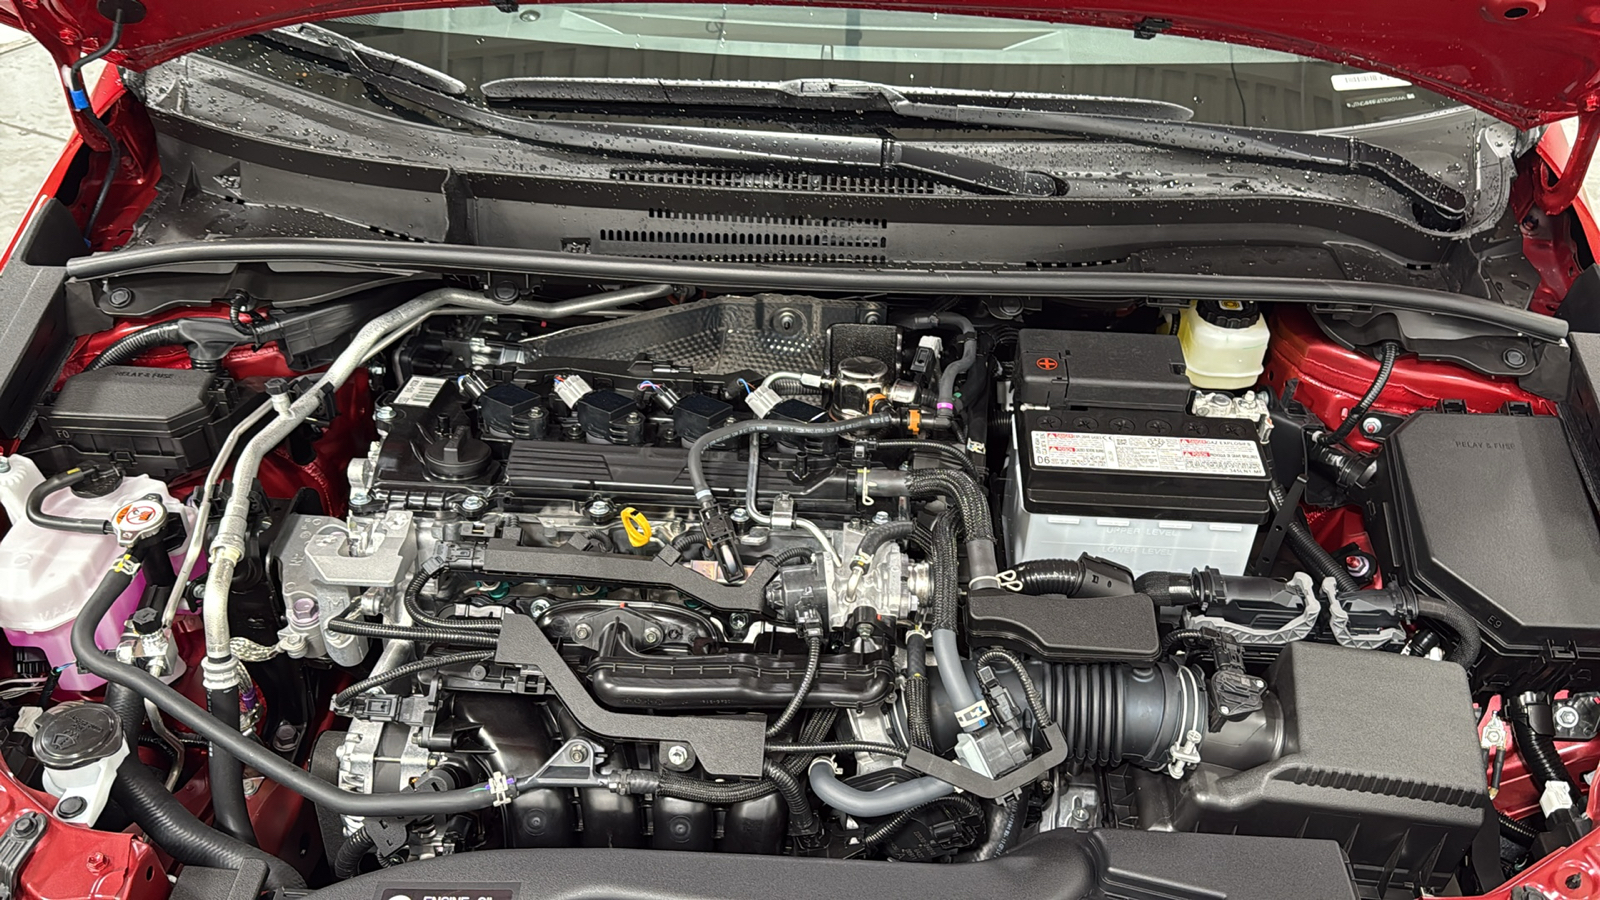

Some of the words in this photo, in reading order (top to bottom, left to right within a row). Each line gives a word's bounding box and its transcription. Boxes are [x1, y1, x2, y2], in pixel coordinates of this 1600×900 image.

[1037, 456, 1051, 464] D6
[1106, 526, 1140, 535] UPPER
[1146, 528, 1178, 537] LEVEL
[1102, 545, 1138, 554] LOWER
[1142, 547, 1173, 556] LEVEL
